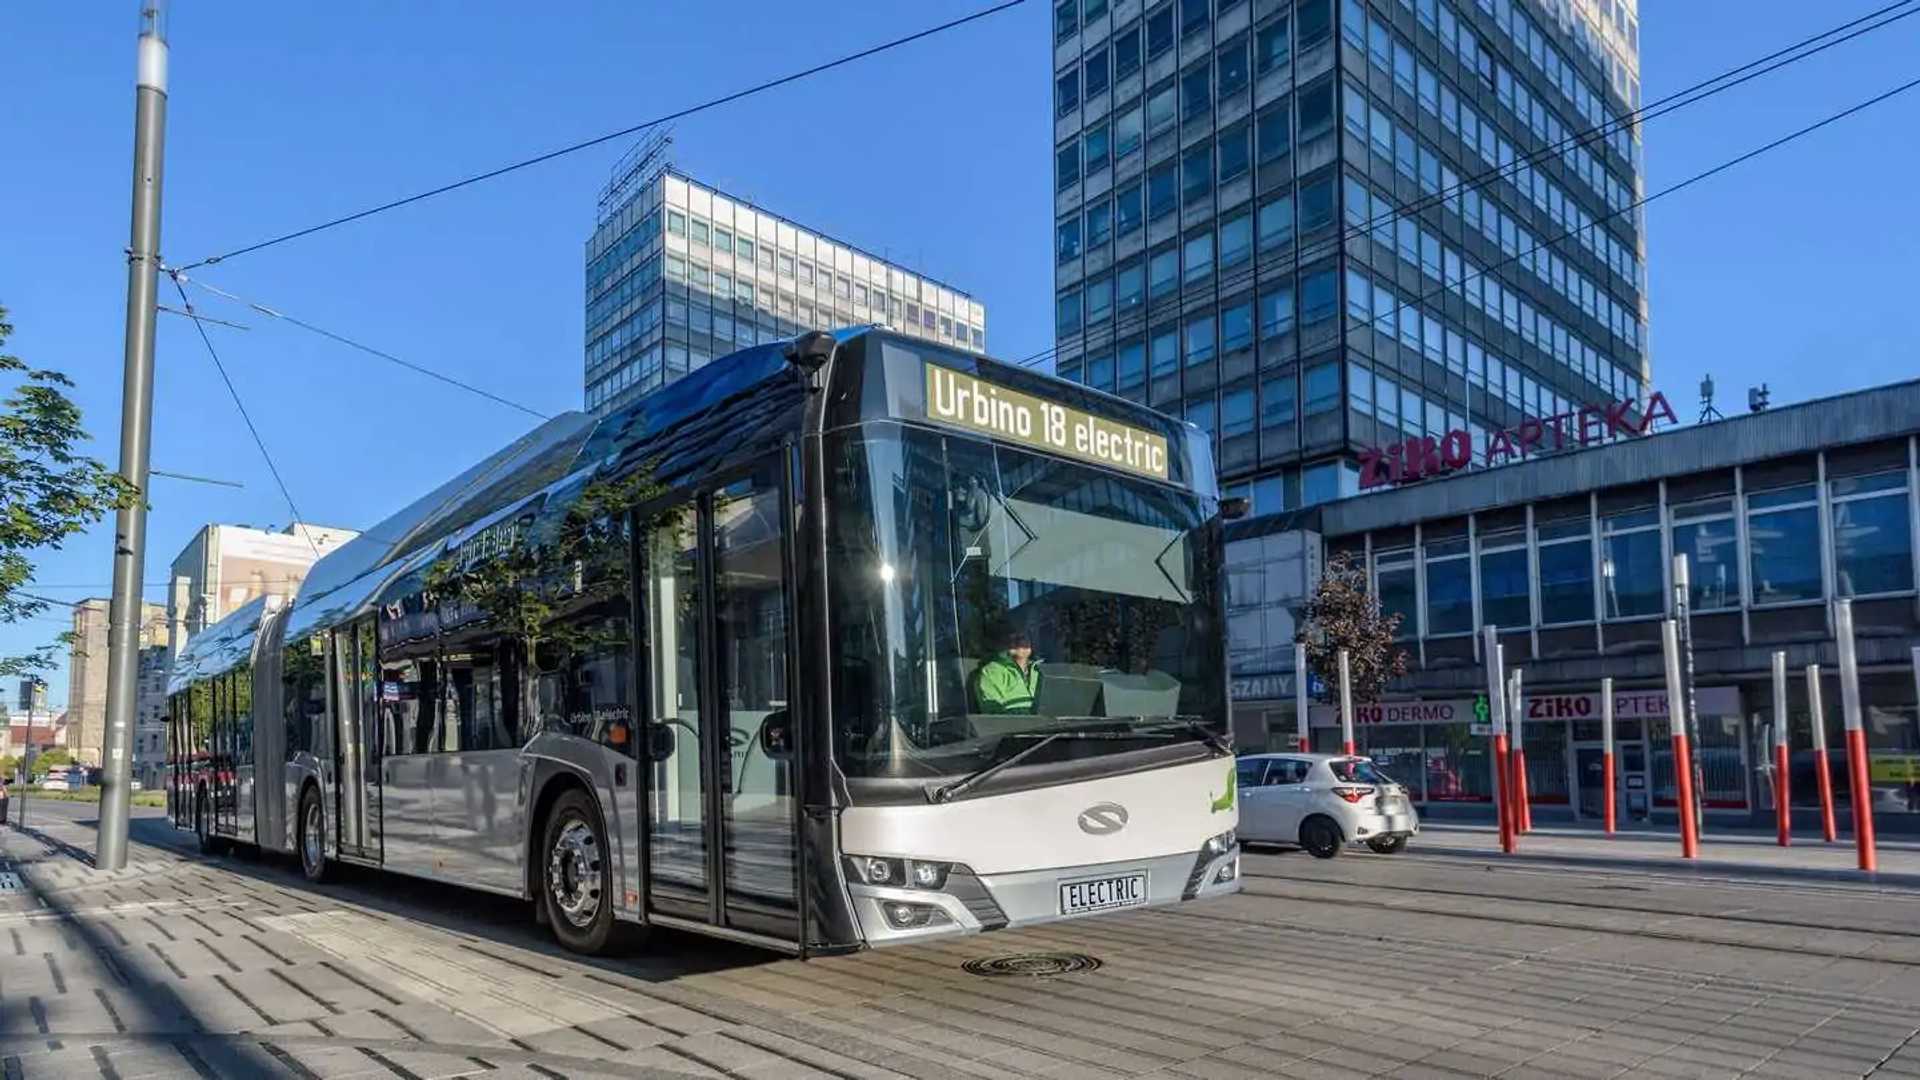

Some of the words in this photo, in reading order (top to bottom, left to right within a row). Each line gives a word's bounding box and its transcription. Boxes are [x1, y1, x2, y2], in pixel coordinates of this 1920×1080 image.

[934, 368, 1031, 436] Urbino
[1040, 402, 1066, 447] 18
[1075, 416, 1164, 472] electric
[1486, 391, 1678, 466] APTEKA
[1387, 703, 1455, 722] DERMO
[1069, 877, 1139, 908] ELECTRIC
